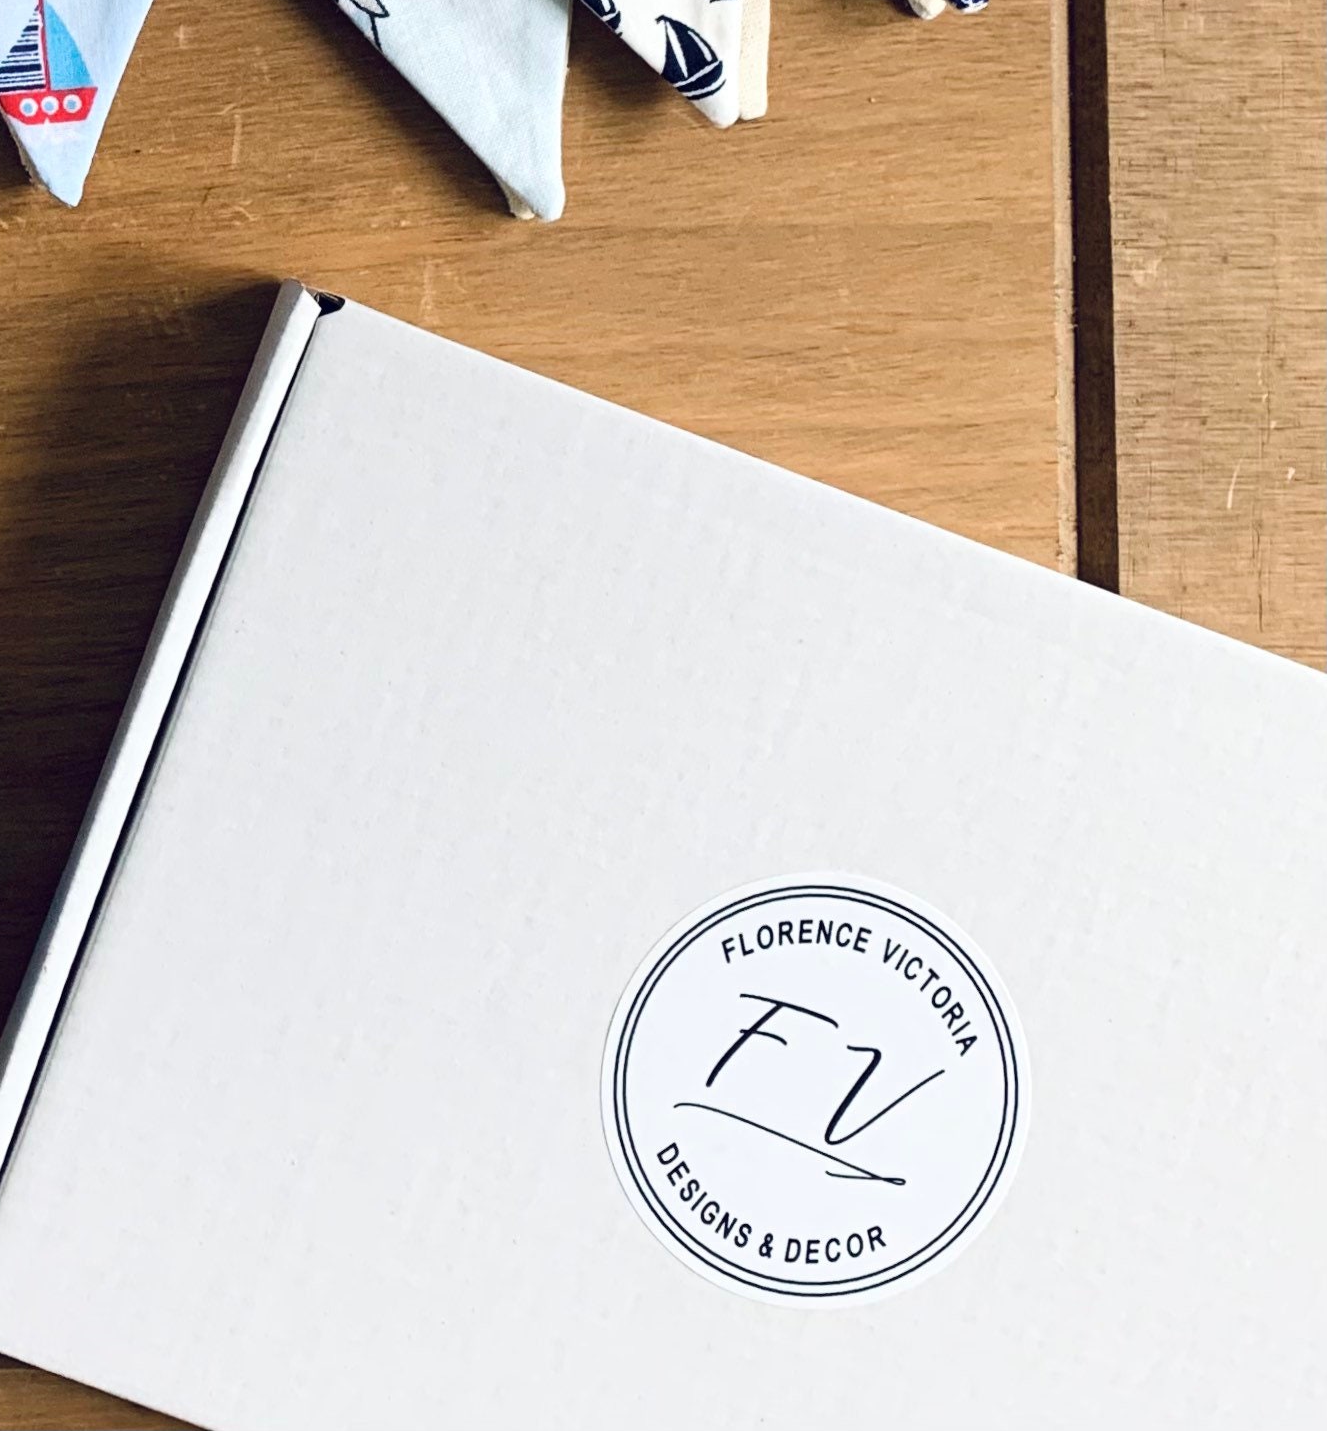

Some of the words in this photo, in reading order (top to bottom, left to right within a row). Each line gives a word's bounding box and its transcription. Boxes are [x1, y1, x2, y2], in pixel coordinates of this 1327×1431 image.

[721, 919, 872, 964] FLORENCE
[883, 938, 978, 1056] VICTORIA
[656, 1142, 753, 1249] DESIGNS
[758, 1233, 774, 1259] &
[784, 1225, 887, 1264] DECOR
